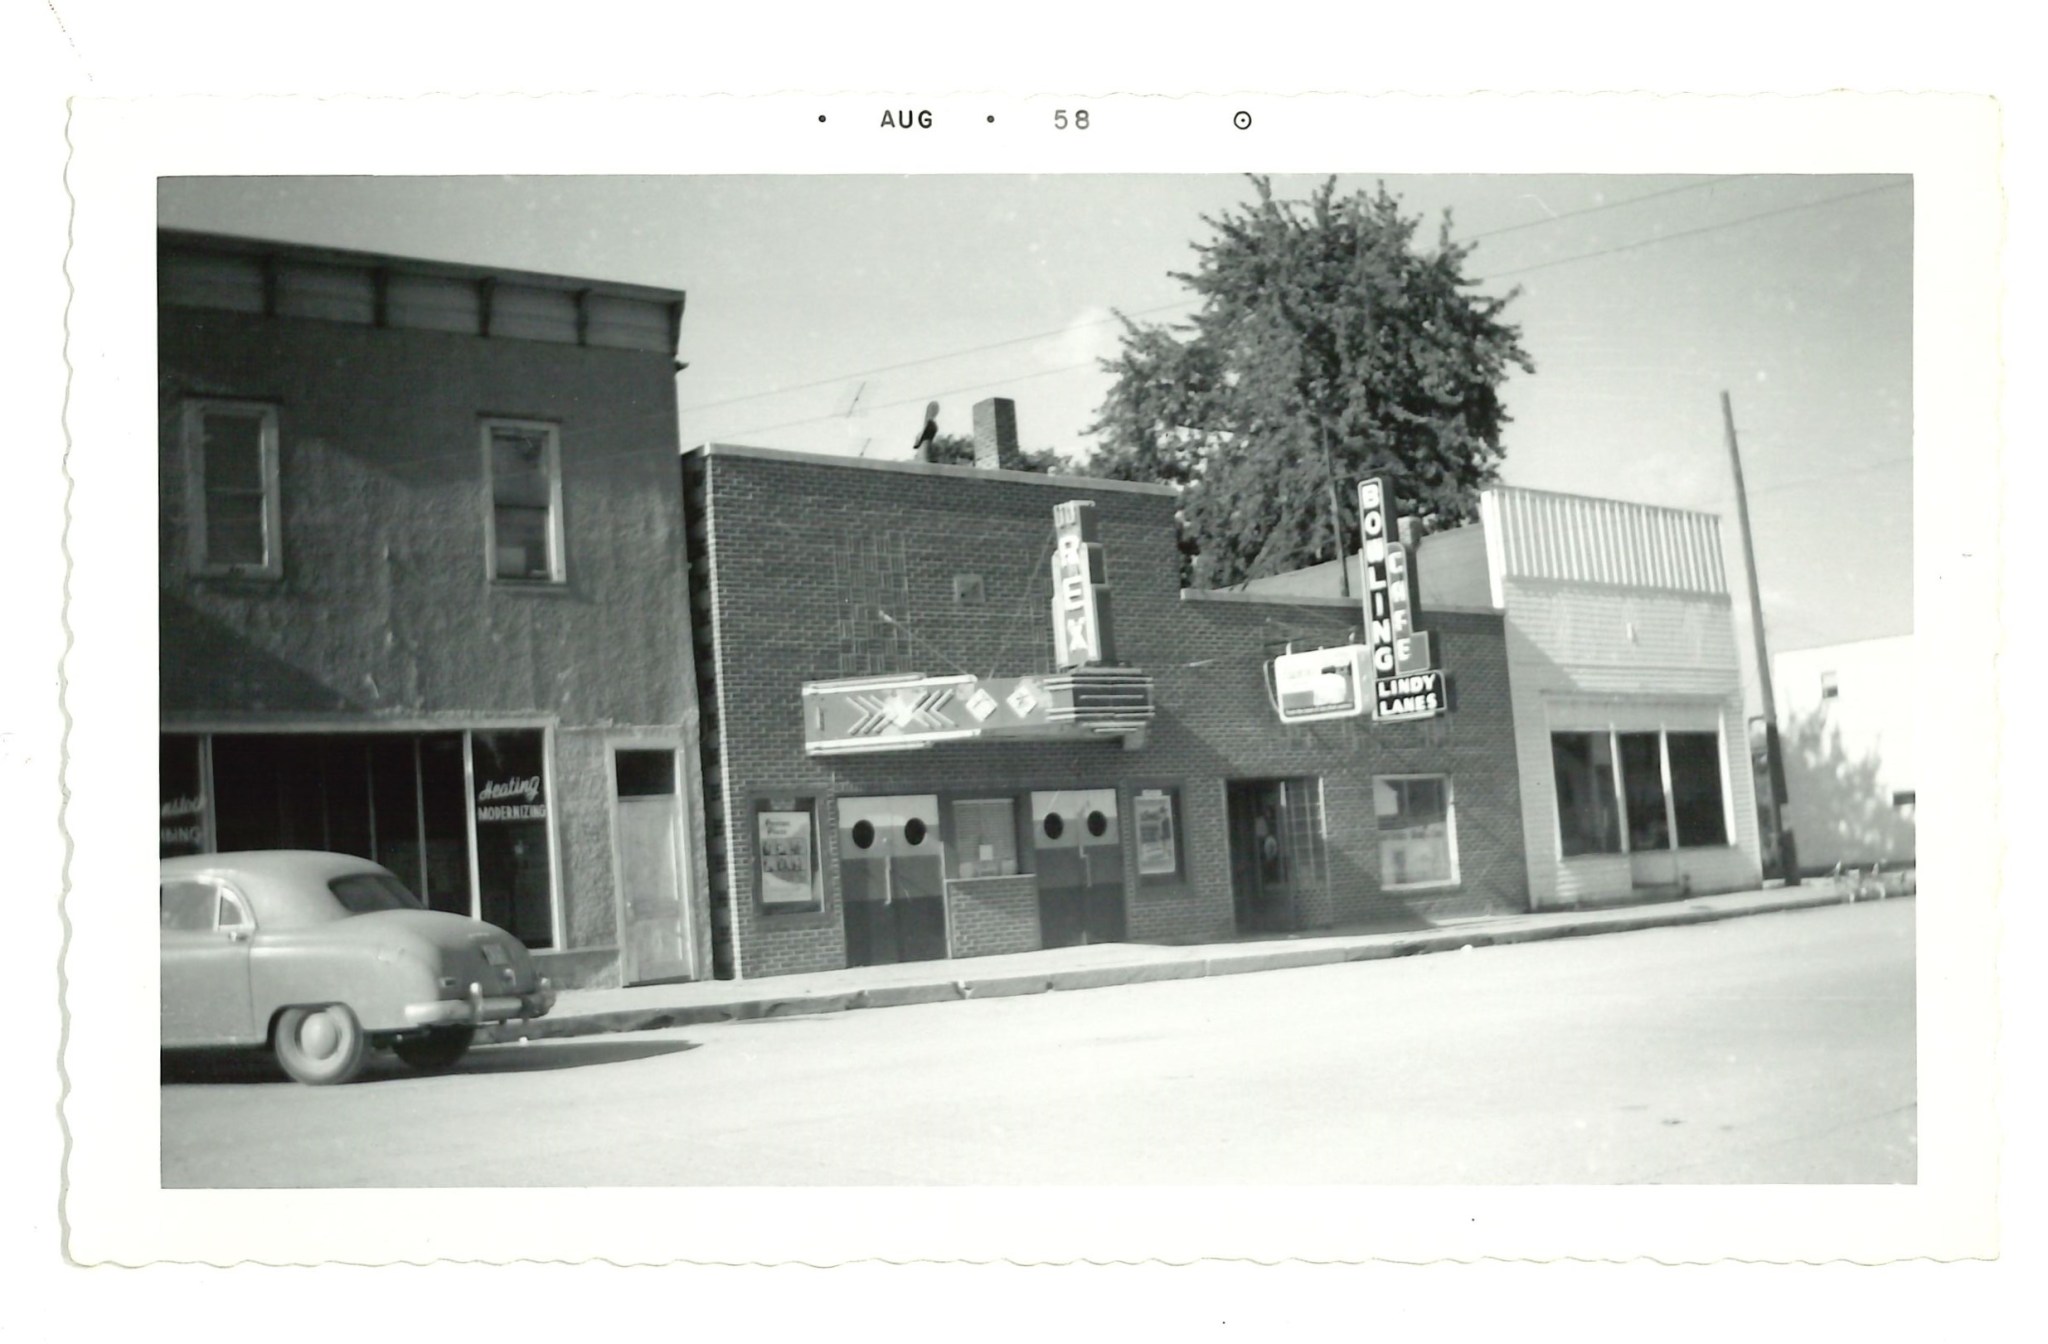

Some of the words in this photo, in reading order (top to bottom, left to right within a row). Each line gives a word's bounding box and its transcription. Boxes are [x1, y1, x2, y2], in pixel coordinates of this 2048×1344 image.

[1361, 483, 1394, 672] BOWLING
[1058, 534, 1088, 651] REX
[1387, 551, 1412, 661] CAFE
[1378, 674, 1436, 697] LINDY
[1380, 693, 1437, 716] LANES
[478, 775, 540, 802] Heating
[477, 804, 547, 821] MODERNIZING
